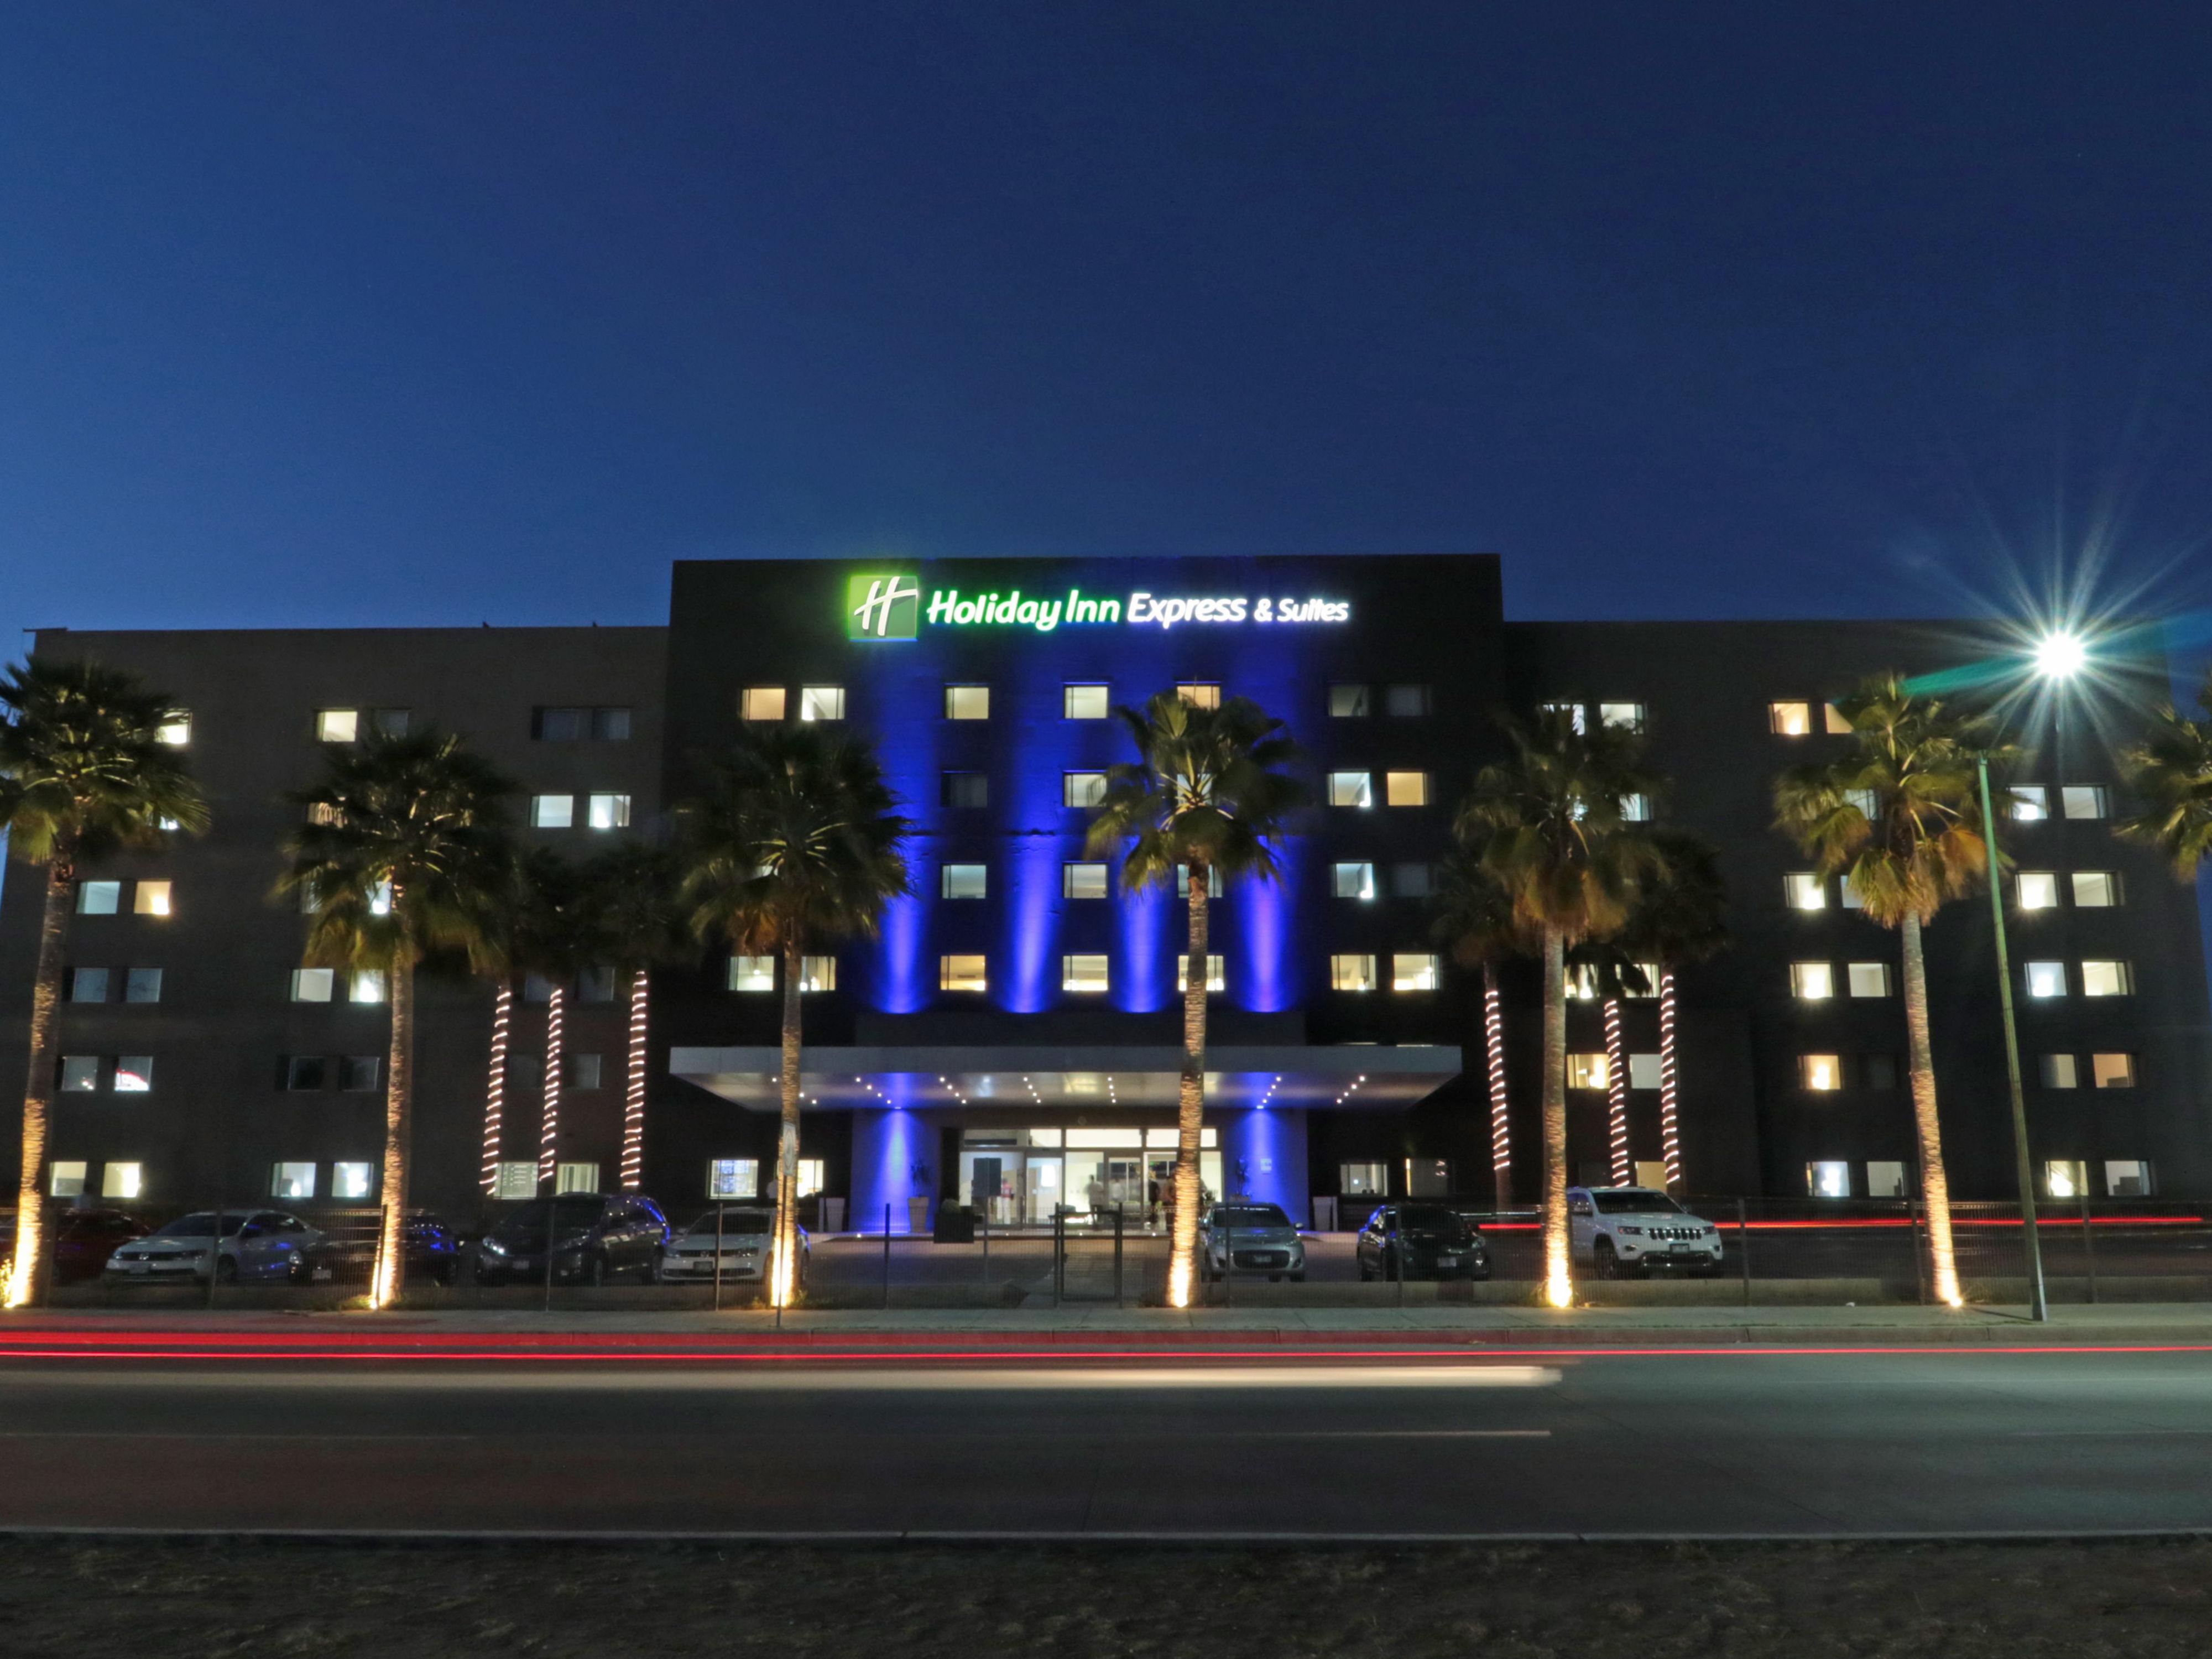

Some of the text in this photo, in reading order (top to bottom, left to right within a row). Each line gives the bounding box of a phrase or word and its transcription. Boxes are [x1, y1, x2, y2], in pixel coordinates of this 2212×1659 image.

[927, 589, 1349, 631] Holiday Inn Express & Suites
